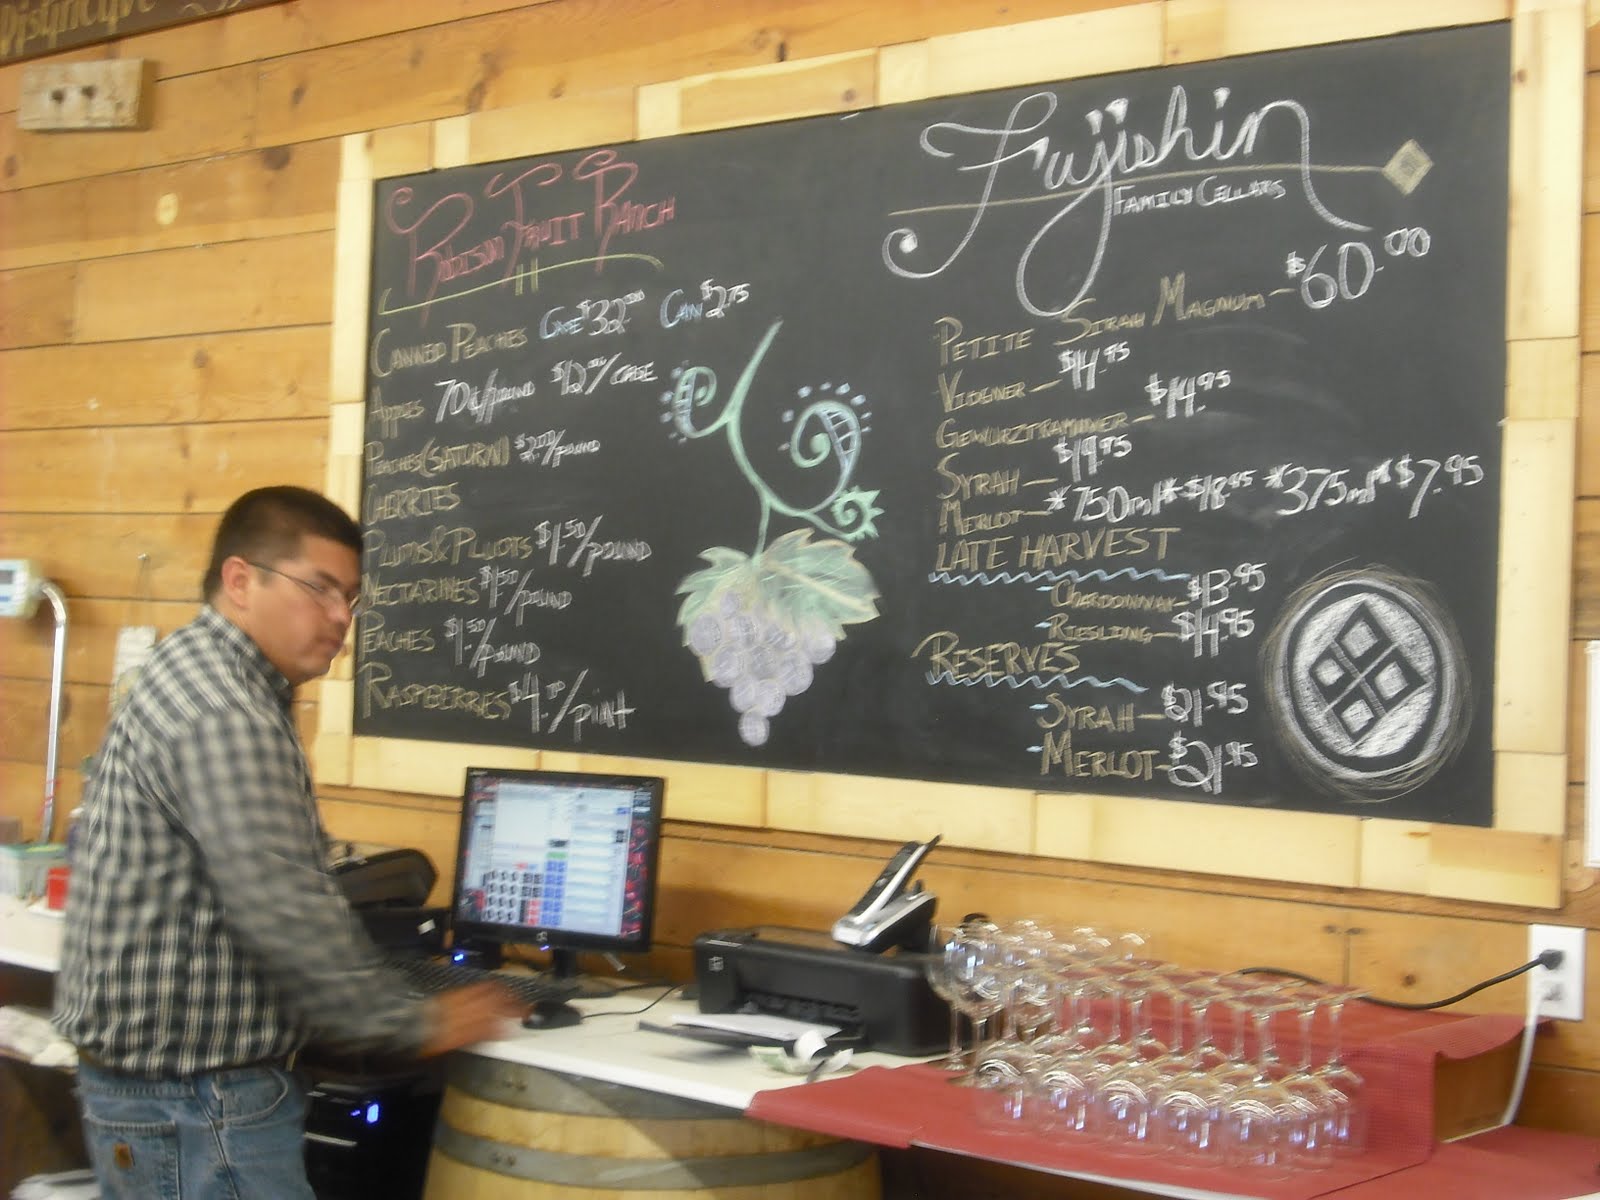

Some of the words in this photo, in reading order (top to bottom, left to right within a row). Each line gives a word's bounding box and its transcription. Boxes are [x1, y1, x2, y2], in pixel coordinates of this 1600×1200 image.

[882, 84, 1374, 316] Fujishin
[934, 316, 1035, 366] PETITE
[936, 452, 1020, 500] SYRAH
[935, 535, 1014, 572] LATE
[1018, 526, 1181, 569] HARVEST
[910, 631, 1081, 678] RESERVES
[1037, 692, 1135, 732] SYRAH
[1040, 729, 1160, 781] MERLOT
